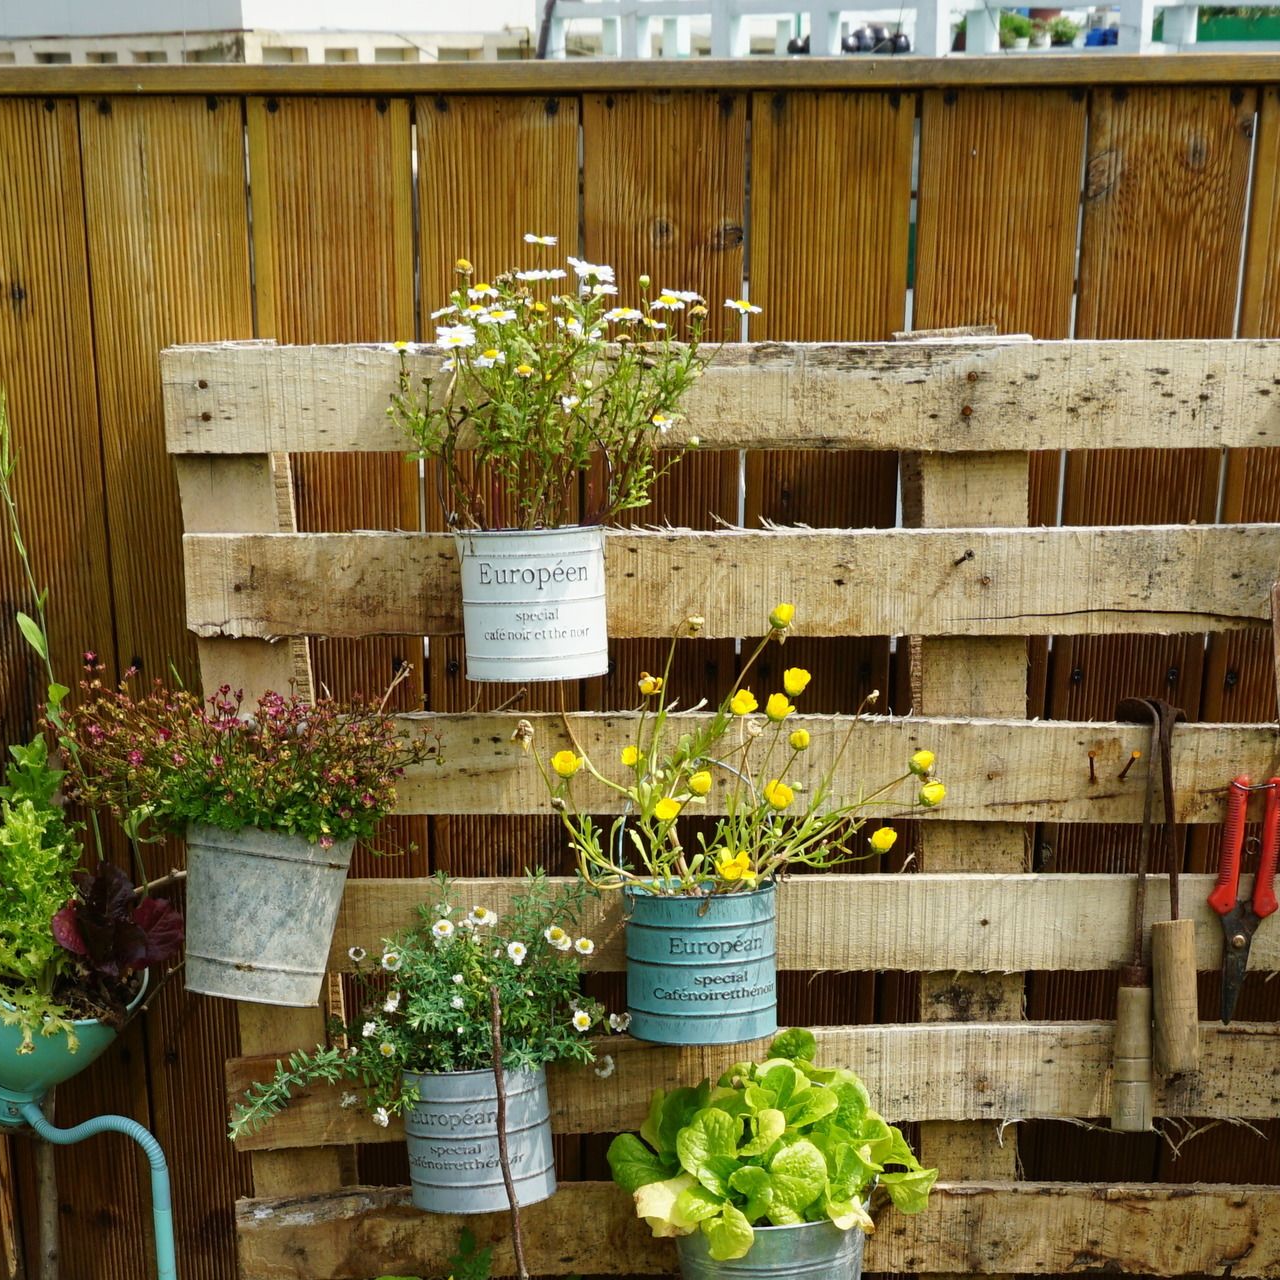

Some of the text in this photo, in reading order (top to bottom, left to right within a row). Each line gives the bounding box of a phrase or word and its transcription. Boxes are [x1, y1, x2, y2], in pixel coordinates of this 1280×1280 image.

[478, 560, 589, 591] Européen
[515, 608, 560, 625] special
[534, 629, 547, 641] et
[668, 934, 763, 959] Européan
[694, 970, 748, 988] special
[430, 1143, 482, 1157] special
